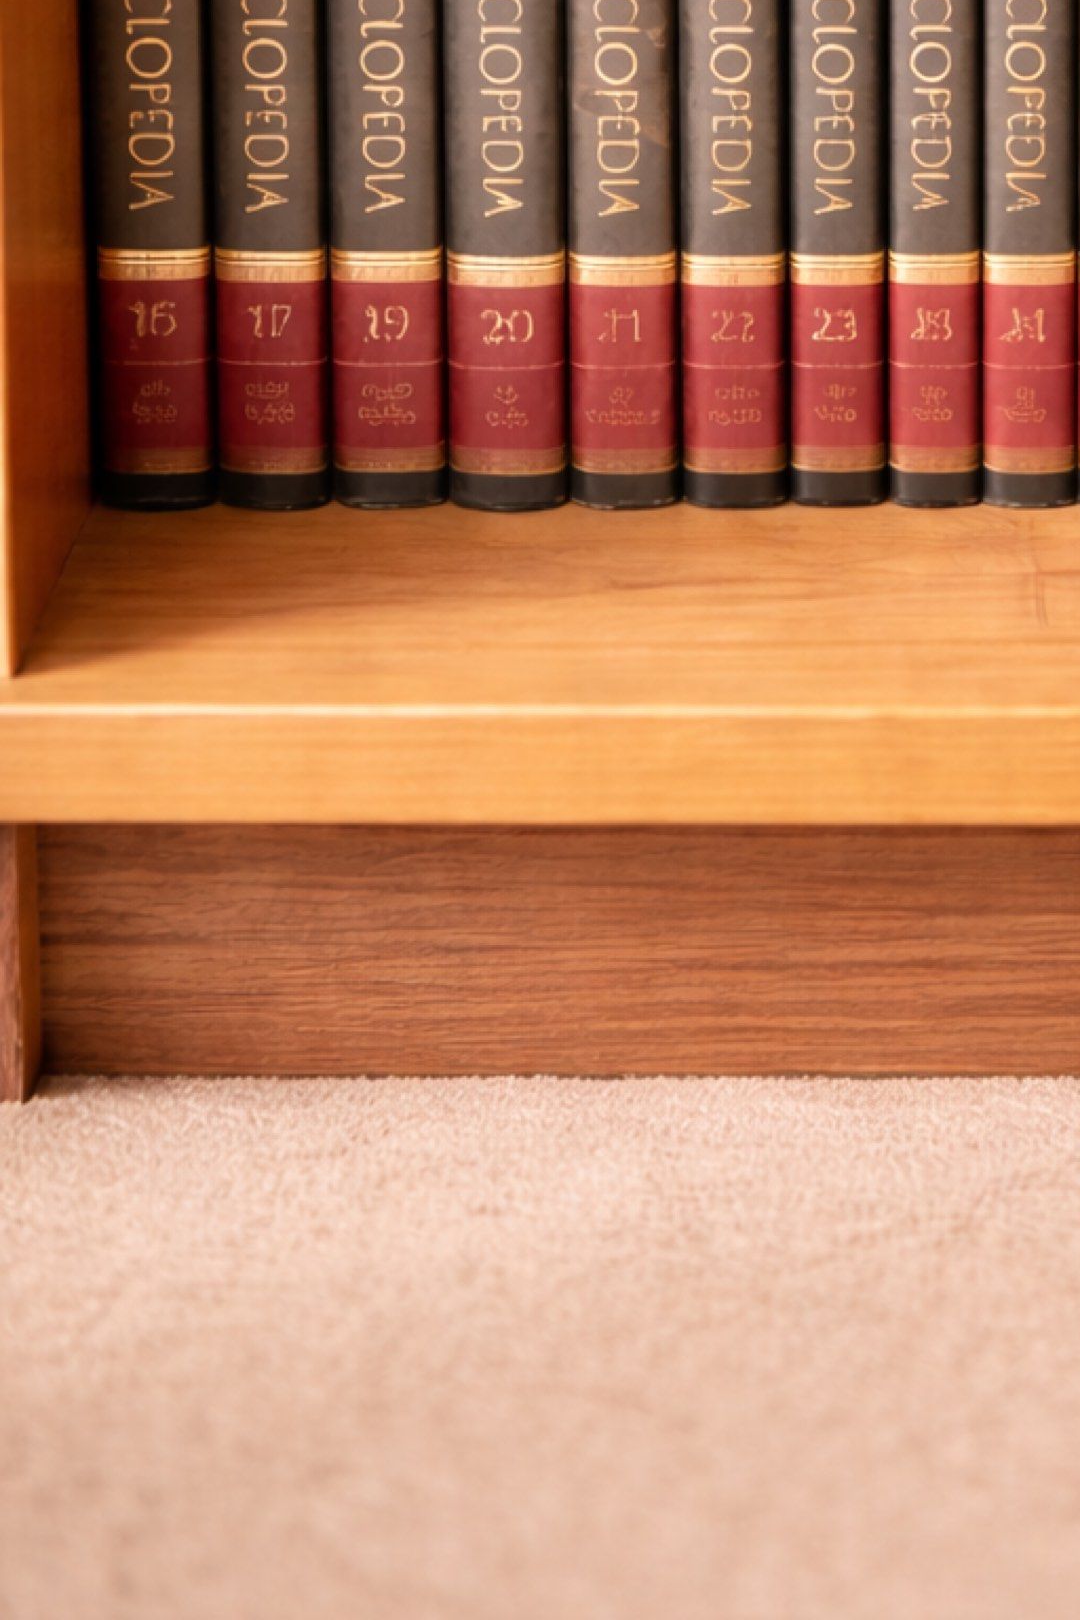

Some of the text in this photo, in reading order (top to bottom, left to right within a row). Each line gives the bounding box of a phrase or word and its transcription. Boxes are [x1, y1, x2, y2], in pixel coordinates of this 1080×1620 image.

[128, 302, 177, 338] 16
[248, 304, 291, 338] 17
[363, 304, 409, 342] 19
[481, 309, 534, 344] 20
[812, 307, 857, 340] 23
